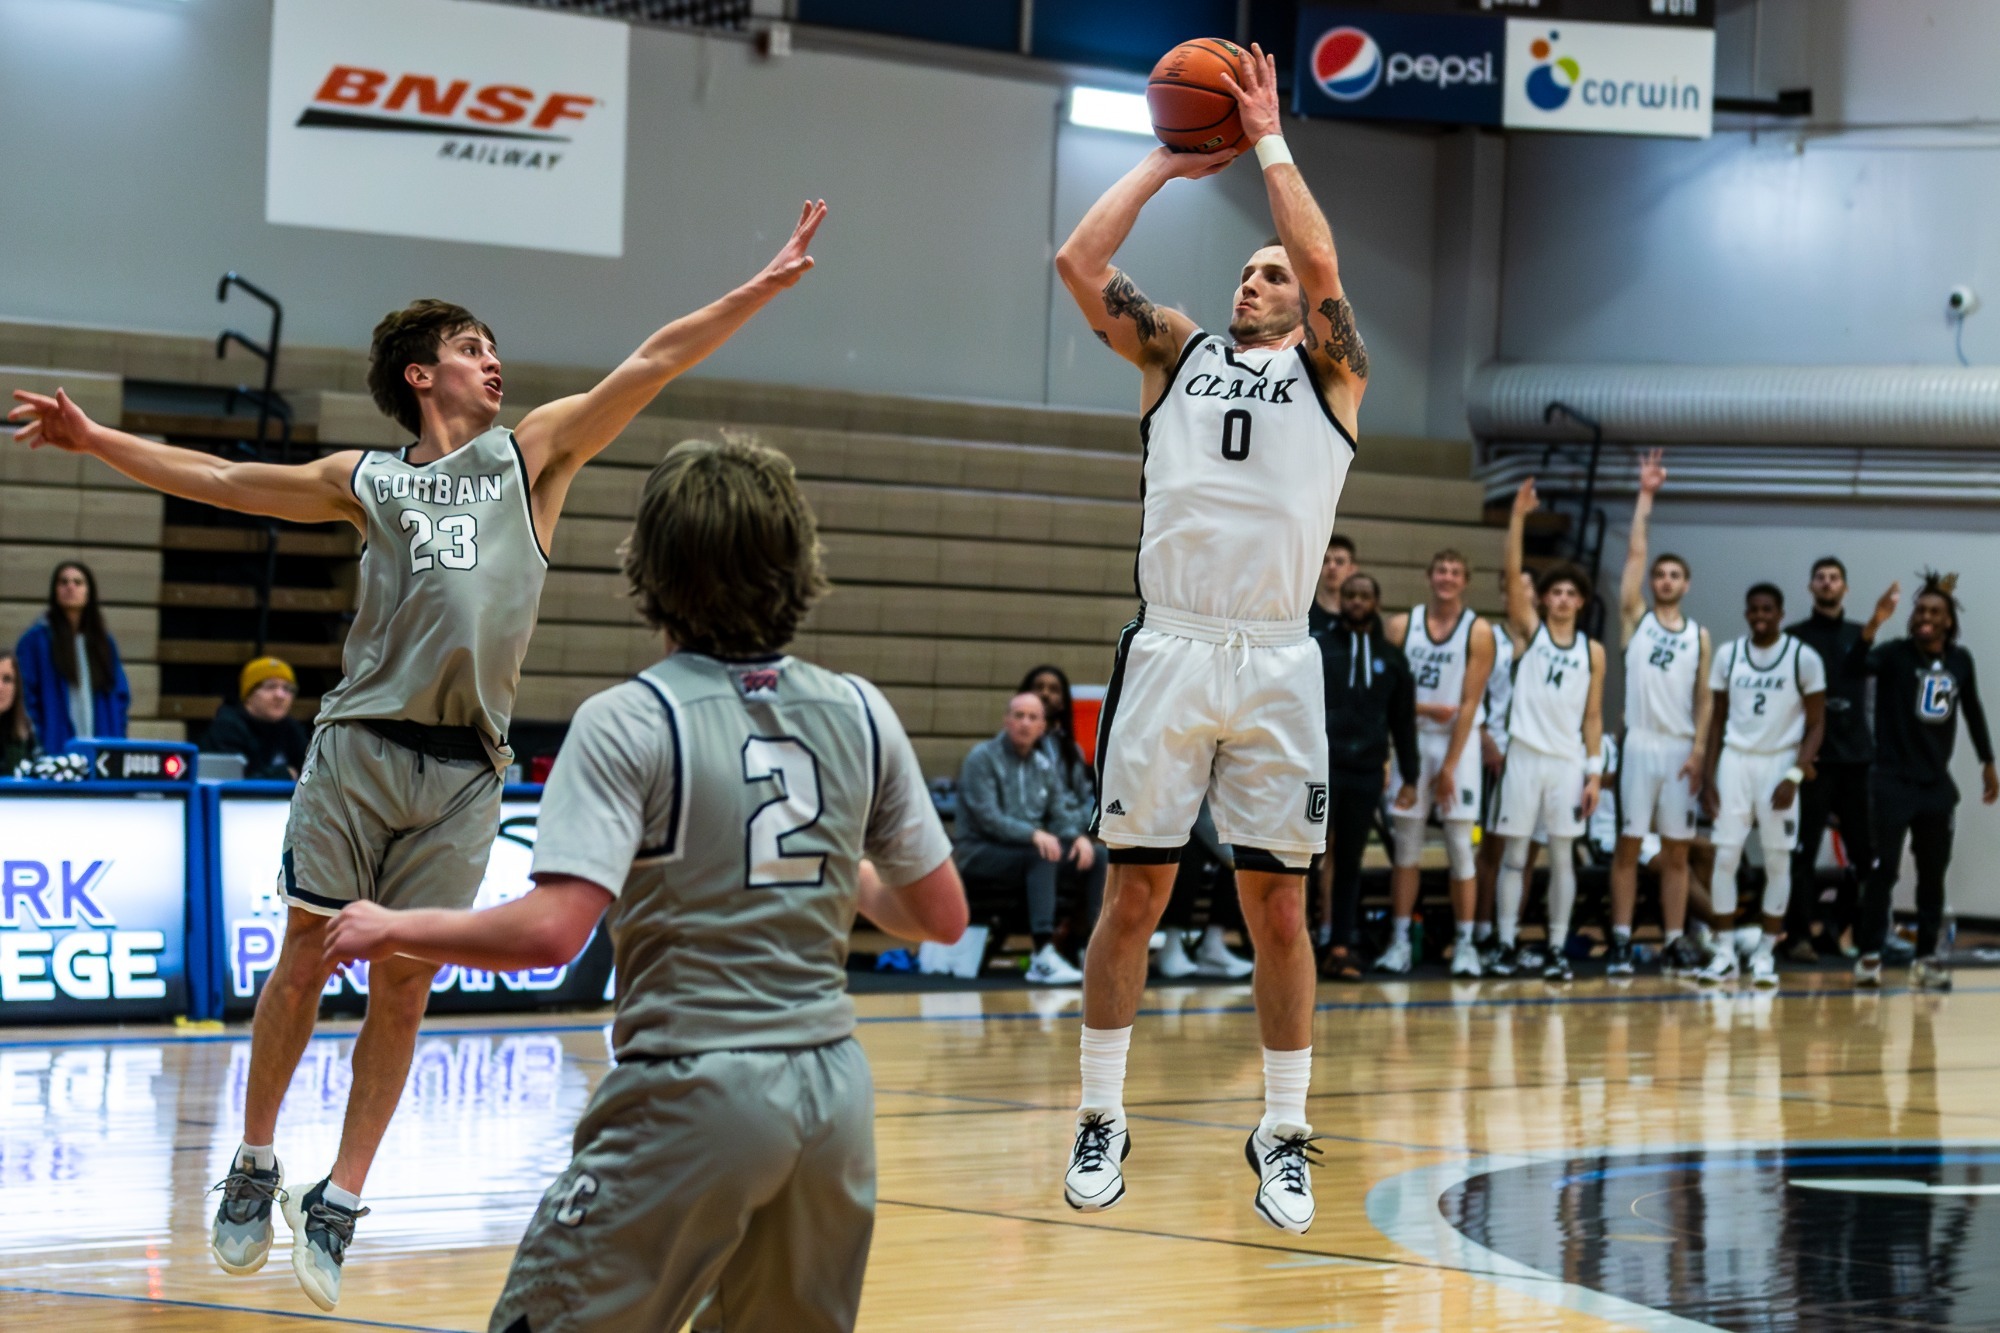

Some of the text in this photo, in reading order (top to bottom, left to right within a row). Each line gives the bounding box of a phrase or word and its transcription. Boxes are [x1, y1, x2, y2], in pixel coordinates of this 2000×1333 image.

[1386, 52, 1492, 88] pepsi
[314, 64, 596, 130] BNSF
[1581, 75, 1699, 111] corwin
[437, 140, 563, 170] RAILWAY
[1185, 373, 1299, 404] CLARK
[1221, 408, 1252, 461] 0
[372, 472, 503, 507] CORBAN
[399, 507, 479, 577] 23
[1648, 645, 1676, 672] 22
[1417, 663, 1441, 690] 23
[1545, 664, 1564, 689] 14
[1735, 675, 1787, 690] CLARK
[1753, 692, 1767, 716] 2
[741, 734, 828, 890] 2
[0, 859, 117, 928] RK
[0, 930, 167, 1001] EGE
